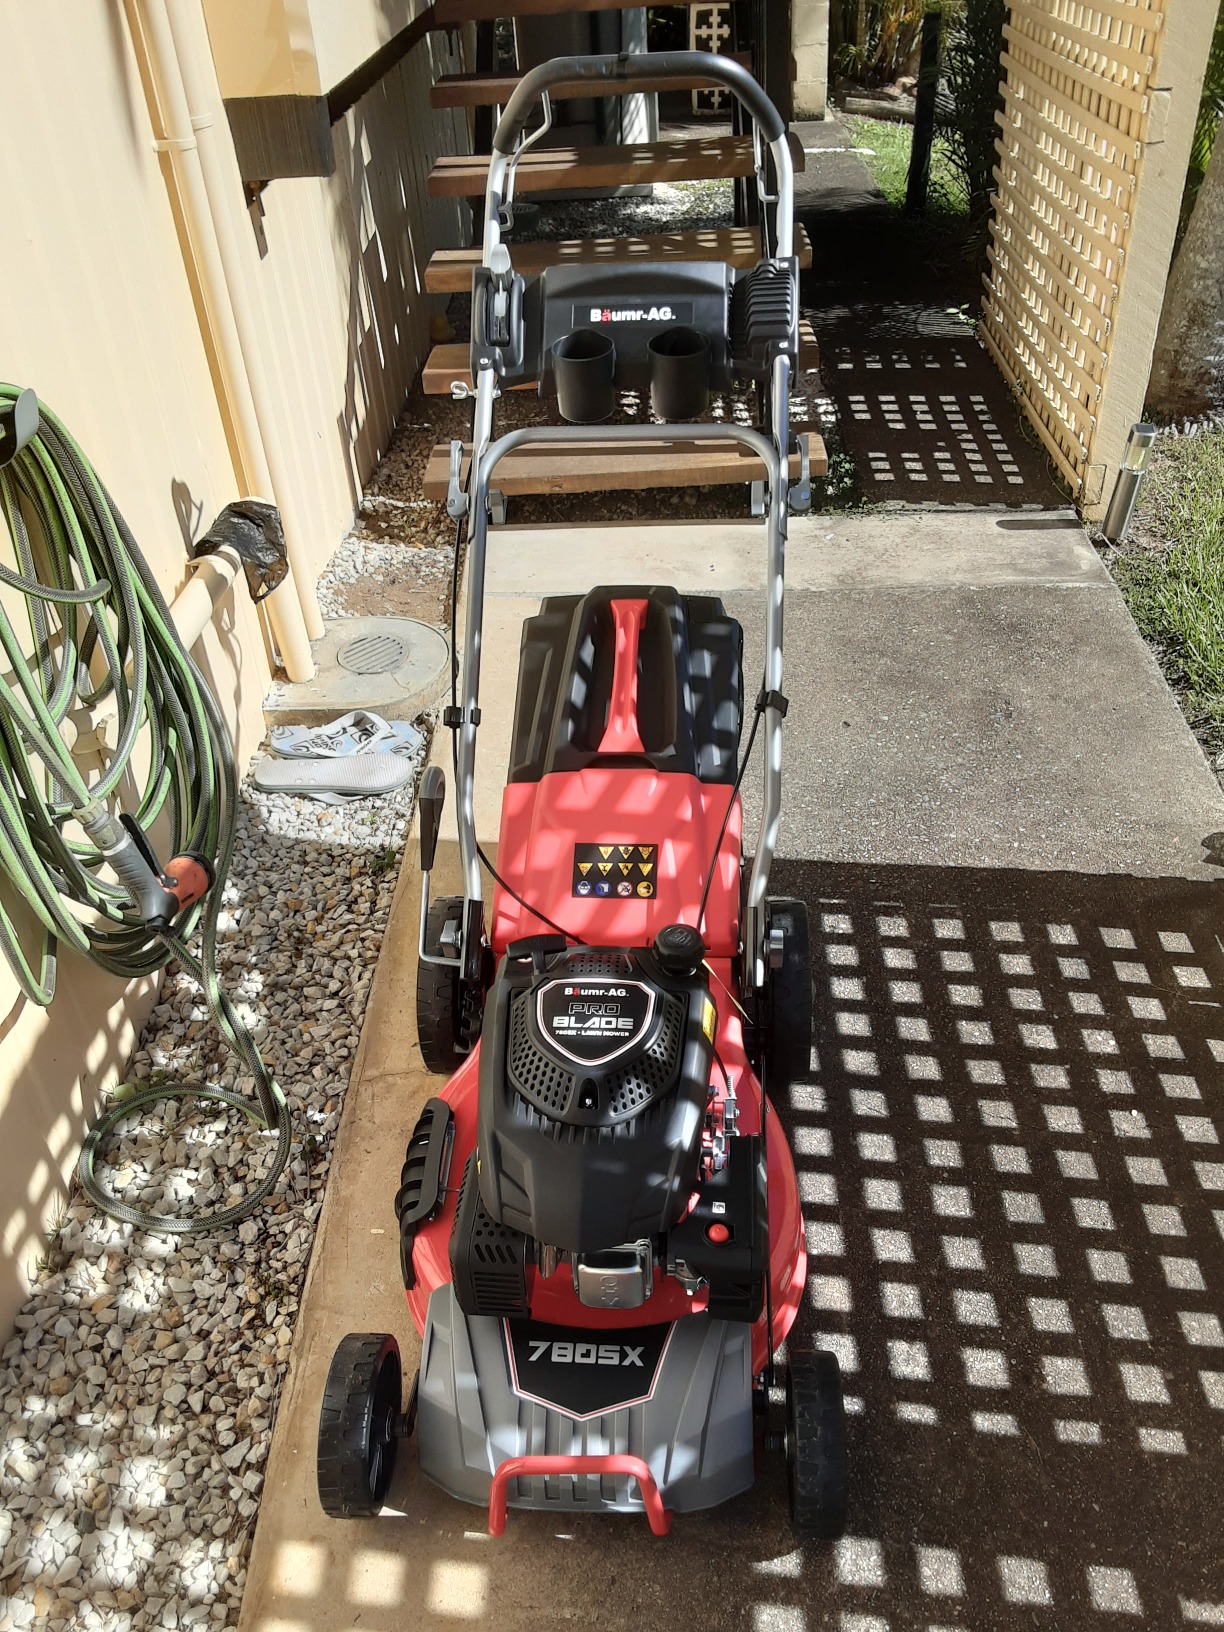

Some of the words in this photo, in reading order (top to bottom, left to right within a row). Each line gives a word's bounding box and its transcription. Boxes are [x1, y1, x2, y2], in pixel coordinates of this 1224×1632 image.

[568, 1002, 621, 1016] PRO
[552, 1016, 634, 1029] BLADE
[528, 1340, 645, 1367] 780SX
